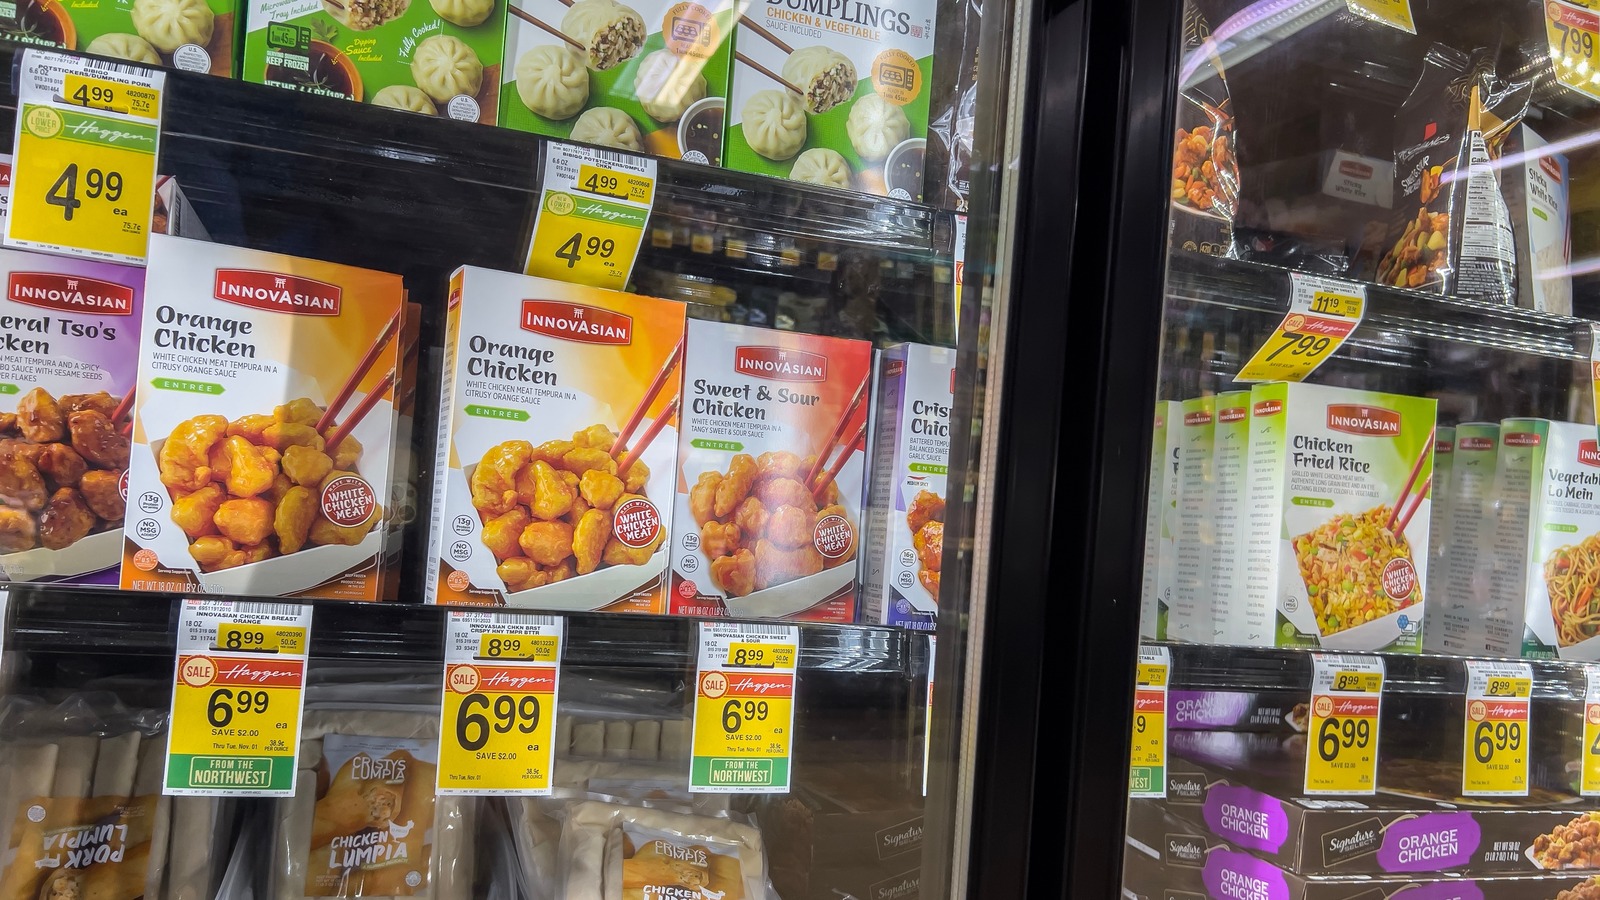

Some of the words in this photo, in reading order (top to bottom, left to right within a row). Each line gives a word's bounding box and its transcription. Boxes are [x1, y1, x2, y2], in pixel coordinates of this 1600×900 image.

[270, 9, 286, 20] Tray
[288, 3, 319, 16] Included
[412, 19, 442, 38] Cooked!
[766, 19, 788, 31] SAUCE
[789, 24, 822, 39] INCLUDED
[767, 6, 812, 26] CHICKEN
[814, 17, 822, 27] &
[825, 19, 881, 41] VEGETABLE
[346, 46, 372, 55] Sauce
[29, 67, 40, 75] 6.6
[40, 67, 49, 76] OZ
[83, 67, 109, 76] BIBIGO
[266, 56, 282, 68] KEEP
[284, 58, 309, 71] FROZEN
[131, 81, 152, 89] PORK
[30, 116, 57, 128] LOWER
[65, 120, 154, 143] Haggen
[113, 207, 128, 217] ea
[577, 204, 644, 221] Haggen
[14, 284, 127, 310] INNOVASIAN
[221, 281, 336, 312] INNOVASIAN
[0, 315, 50, 334] eral
[57, 318, 117, 341] Tso's
[155, 305, 253, 336] Orange
[527, 311, 627, 340] INNOVASIAN
[1287, 319, 1302, 328] SALE
[1306, 321, 1349, 333] Haggen
[153, 329, 256, 359] Chicken
[469, 335, 554, 367] Orange
[4, 355, 23, 365] MEAT
[25, 357, 57, 367] TEMPURA
[58, 360, 73, 369] AND
[81, 362, 100, 372] SPICY
[151, 361, 181, 373] CITRUSY
[182, 364, 213, 376] ORANGE
[214, 367, 237, 378] SAUCE
[152, 352, 176, 363] WHITE
[177, 353, 207, 366] CHICKEN
[208, 357, 227, 368] MEAT
[229, 359, 261, 371] TEMPURA
[740, 356, 823, 377] INNOVASIAN
[11, 363, 33, 374] SAUCE
[35, 366, 53, 376] WITH
[54, 369, 81, 379] SESAME
[82, 371, 103, 381] SEEDS
[11, 372, 37, 383] FLAKES
[467, 357, 557, 386] Chicken
[164, 380, 213, 393] ENTRÉE
[466, 380, 488, 391] WHITE
[488, 382, 516, 394] CHICKEN
[517, 386, 534, 396] MEAT
[534, 387, 564, 399] TEMPURA
[693, 379, 751, 401] Sweet
[756, 385, 772, 402] &
[778, 388, 820, 407] Sour
[465, 390, 491, 402] CITRUSY
[492, 392, 519, 403] ORANGE
[520, 395, 541, 405] SAUCE
[476, 407, 519, 419] ENTRÉE
[692, 398, 766, 421] Chicken
[911, 418, 951, 437] Chic
[1331, 413, 1397, 432] INNOVASIAN
[1293, 434, 1353, 455] Chicken
[1292, 452, 1335, 471] Fried
[1338, 456, 1371, 474] Rice
[144, 494, 159, 503] 13g
[328, 487, 367, 503] WHITE
[1548, 485, 1562, 498] Lo
[1565, 486, 1593, 500] Mein
[324, 494, 374, 514] CHICKEN
[336, 506, 368, 521] MEAT
[457, 517, 471, 526] 13g
[619, 510, 652, 524] WHITE
[140, 526, 157, 534] MSG
[616, 516, 659, 535] CHICKEN
[818, 524, 846, 539] WHITE
[625, 527, 653, 541] MEAT
[816, 530, 851, 546] CHICKEN
[453, 548, 469, 556] MSG
[823, 539, 846, 551] MEAT
[1383, 573, 1416, 590] CHICKEN
[1386, 567, 1410, 582] WHITE
[1391, 583, 1411, 595] MEAT
[196, 611, 238, 619] INNOVASIAN
[469, 623, 507, 631] INNOVASIAN
[186, 665, 212, 678] SALE
[219, 664, 301, 682] Haggen
[453, 674, 475, 685] SALE
[482, 672, 553, 687] Haggen
[705, 681, 724, 690] SALE
[730, 678, 791, 693] Haggen
[1316, 702, 1331, 712] SALE
[1335, 700, 1378, 713] Haggen
[1471, 706, 1484, 715] SALE
[1488, 705, 1527, 715] Haggen
[211, 729, 235, 737] SAVE
[237, 729, 259, 737] $2.00
[210, 760, 234, 769] FROM
[237, 760, 253, 770] THE
[725, 761, 744, 769] FROM
[746, 761, 758, 769] THE
[194, 769, 267, 785] NORTHWEST
[713, 770, 769, 783] NORTHWEST
[1170, 779, 1201, 795] Signature
[1221, 803, 1269, 826] ORANGE
[1221, 816, 1269, 840] CHICKEN
[331, 831, 388, 849] CHICKEN
[1329, 829, 1375, 852] Signature
[1399, 829, 1458, 850] ORANGE
[329, 842, 408, 869] LUMPIA
[1398, 842, 1458, 864] CHICKEN
[1221, 868, 1269, 895] ORANGE
[643, 884, 702, 899] CHICKEN
